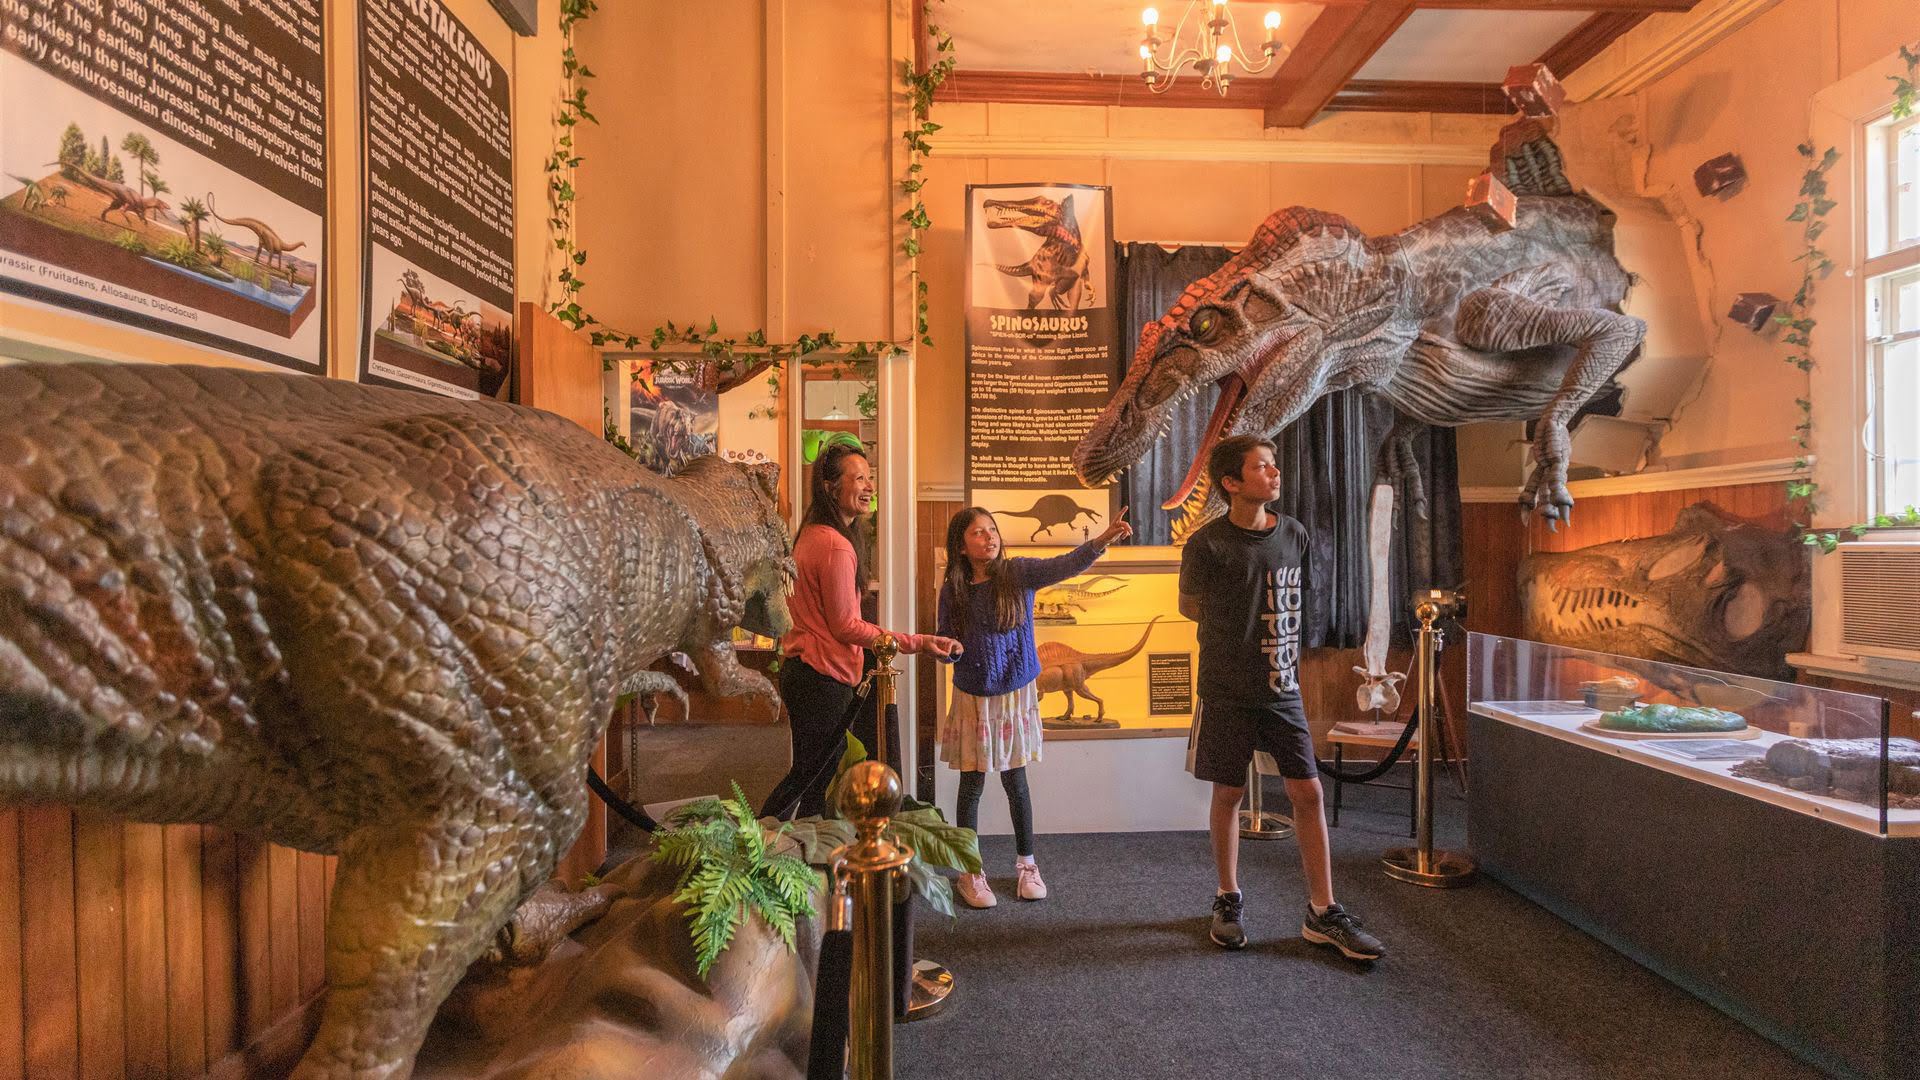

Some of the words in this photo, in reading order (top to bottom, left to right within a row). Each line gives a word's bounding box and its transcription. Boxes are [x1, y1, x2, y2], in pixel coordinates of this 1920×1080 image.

[224, 24, 249, 50] their
[254, 46, 278, 71] mark
[282, 64, 291, 81] in
[296, 77, 302, 88] a
[306, 80, 321, 102] big
[302, 17, 319, 37] and
[303, 35, 320, 54] and
[6, 22, 47, 59] early
[52, 50, 158, 116] coelurosaurian
[161, 109, 216, 148] dinosaur.
[33, 12, 73, 46] skies
[78, 35, 91, 57] in
[95, 47, 118, 72] the
[121, 61, 146, 87] late
[149, 79, 203, 123] Jurassic,
[205, 114, 233, 138] most
[234, 128, 262, 156] likely
[263, 148, 299, 175] evolved
[300, 166, 322, 188] from
[63, 2, 91, 32] The
[97, 28, 148, 67] earliest
[152, 57, 193, 94] known
[196, 85, 222, 114] bird,
[225, 104, 298, 159] Archaeopteryx,
[301, 150, 322, 170] took
[111, 10, 143, 42] from
[150, 36, 216, 90] Allosaurus,
[222, 84, 228, 96] a
[233, 88, 264, 120] bulky,
[268, 113, 322, 155] meat-eating
[155, 15, 185, 48] long.
[215, 59, 245, 86] sheer
[250, 83, 270, 103] size
[275, 99, 295, 121] may
[299, 111, 322, 135] have
[212, 37, 262, 78] sauropod
[266, 71, 321, 119] Diplodocus,
[371, 148, 390, 169] south.
[371, 171, 388, 192] Much
[389, 186, 396, 197] of
[396, 189, 408, 205] this
[408, 198, 419, 213] rich
[466, 237, 489, 256] non-avian
[489, 250, 513, 271] dinosaurs,
[371, 222, 389, 239] years
[390, 233, 403, 247] ago.
[371, 190, 406, 220] pterosaurs,
[408, 214, 435, 238] pliosaurs,
[437, 233, 449, 245] and
[503, 269, 508, 280] in
[371, 206, 388, 223] great
[389, 217, 417, 240] extinction
[417, 235, 433, 250] event
[434, 244, 439, 254] at
[440, 246, 450, 259] the
[450, 253, 460, 265] end
[460, 259, 466, 268] of
[466, 261, 475, 274] this
[476, 269, 491, 283] period
[492, 276, 498, 286] 66
[498, 281, 513, 294] million
[38, 265, 98, 292] (Fruitadens,
[100, 284, 149, 306] Allosaurus,
[151, 299, 198, 321] Diplodocus)
[990, 315, 1088, 332] SPINOSAURUS
[1261, 567, 1301, 694] adidas
